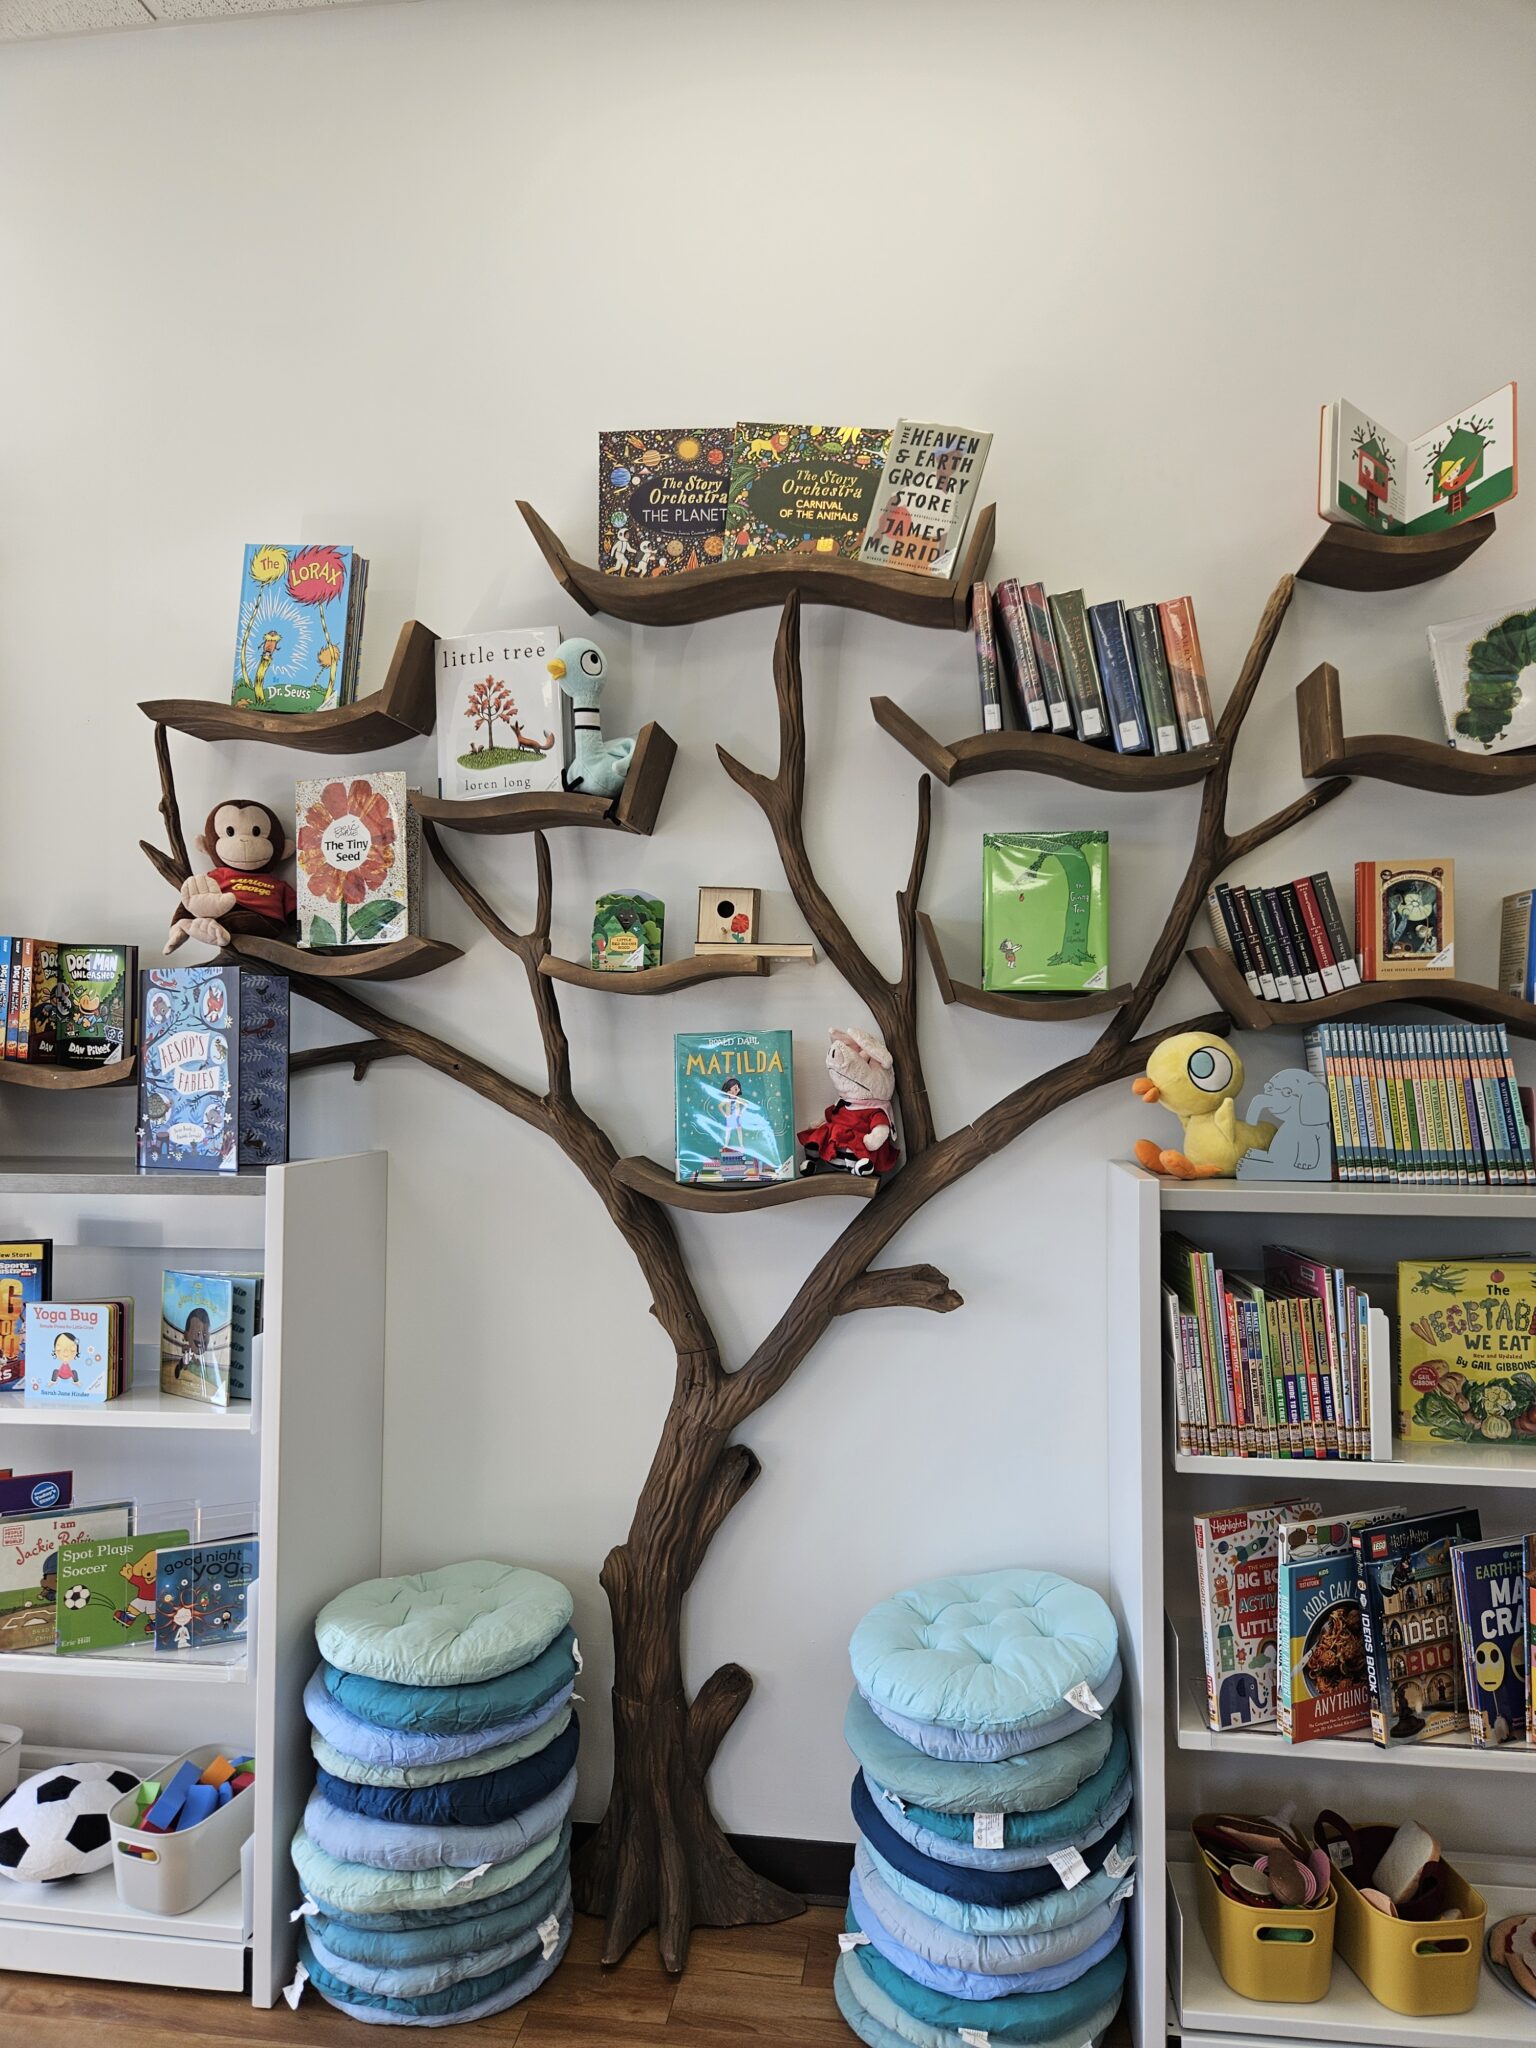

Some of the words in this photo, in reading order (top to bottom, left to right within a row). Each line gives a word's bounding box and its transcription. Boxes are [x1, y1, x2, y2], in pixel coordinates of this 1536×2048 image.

[901, 426, 912, 445] THE
[910, 427, 980, 454] HEAVEN
[895, 449, 910, 464] &
[915, 450, 973, 473] EARTH
[662, 477, 683, 489] The
[685, 475, 723, 492] Story
[797, 470, 818, 480] The
[820, 470, 858, 487] Story
[888, 468, 969, 495] GROCERY
[649, 488, 728, 504] Orchestra
[782, 479, 863, 499] Orchestra
[795, 499, 843, 511] CARNIVAL
[891, 490, 951, 513] STORE
[642, 509, 669, 522] THE
[675, 508, 727, 522] PLANET
[780, 509, 793, 518] OF
[796, 510, 815, 519] THE
[817, 511, 859, 522] ANIMALS
[882, 518, 945, 543] JAMES
[863, 537, 949, 563] McBRID
[260, 558, 279, 570] The
[290, 562, 341, 586] LORAX
[443, 646, 495, 668] little
[504, 646, 546, 660] tree
[1071, 615, 1085, 655] HARRY
[1079, 657, 1093, 697] POTTER
[268, 686, 283, 699] Dr.
[284, 684, 311, 699] Seuss
[465, 780, 498, 791] loren
[503, 776, 531, 789] long
[324, 842, 344, 851] The
[346, 840, 368, 851] Tiny
[336, 852, 360, 862] Seed
[232, 883, 271, 896] George
[66, 954, 91, 973] DOG
[92, 953, 118, 972] MAN
[1256, 953, 1265, 970] REPTILE
[12, 964, 21, 979] DOG
[21, 966, 32, 980] DOG
[71, 971, 115, 980] UNLEASHED
[11, 978, 20, 993] MAN
[21, 980, 31, 994] MAN
[39, 1041, 54, 1052] DAV
[68, 1042, 86, 1055] DAV
[708, 1038, 734, 1046] ROALD
[737, 1036, 760, 1045] DAHL
[161, 1035, 205, 1069] AESOP'S
[686, 1050, 785, 1075] MATILDA
[178, 1070, 215, 1094] FABLES
[1430, 1085, 1438, 1096] MY
[1456, 1082, 1464, 1095] THE
[1447, 1079, 1456, 1109] ELEPHANTS
[1476, 1091, 1484, 1110] HAPPY
[1499, 1080, 1509, 1107] WAITING
[1365, 1101, 1371, 1111] MY
[1431, 1095, 1441, 1121] FRIEND
[1458, 1095, 1467, 1115] THANK
[1461, 1115, 1469, 1128] YOU
[1436, 1129, 1444, 1143] SAD
[1463, 1128, 1471, 1145] BOOK
[0, 1262, 29, 1270] Sports
[1486, 1284, 1510, 1296] The
[33, 1307, 66, 1323] Yoga
[70, 1308, 98, 1325] Bug
[1227, 1315, 1236, 1345] SPAGHETTI
[1464, 1334, 1496, 1350] WE
[1499, 1335, 1532, 1351] EAT
[1455, 1355, 1469, 1369] By
[1471, 1360, 1493, 1371] GAIL
[1496, 1360, 1536, 1372] GIBBONS
[1176, 1362, 1184, 1384] EXTRA
[1275, 1378, 1283, 1397] GUIDE
[1287, 1380, 1295, 1399] GUIDE
[1310, 1377, 1318, 1395] GUIDE
[1322, 1375, 1330, 1394] GUIDE
[1178, 1387, 1186, 1406] YARN
[1277, 1398, 1284, 1406] TO
[1289, 1400, 1296, 1409] TO
[1312, 1397, 1319, 1405] TO
[1325, 1396, 1331, 1404] TO
[1325, 1404, 1333, 1420] SURV
[53, 1521, 57, 1530] I
[60, 1521, 76, 1529] am
[1210, 1519, 1247, 1533] Highlights
[1373, 1540, 1386, 1551] LEGO
[1390, 1533, 1409, 1548] Harry
[1409, 1528, 1430, 1544] Potter
[16, 1538, 55, 1566] Jackie
[62, 1550, 94, 1562] Spot
[97, 1544, 134, 1556] Plays
[62, 1564, 108, 1578] Soccer
[164, 1552, 202, 1576] good
[206, 1549, 243, 1564] night
[1475, 1561, 1523, 1580] EARTH-F
[190, 1562, 253, 1583] yoga
[1236, 1570, 1260, 1590] BIG
[1198, 1565, 1207, 1607] HIGHLIGHTS
[1307, 1579, 1320, 1588] KITCHEN
[1280, 1594, 1289, 1612] KIDS
[1302, 1590, 1328, 1621] KIDS
[1329, 1580, 1352, 1602] CAN
[1280, 1614, 1289, 1630] CAN
[77, 1636, 91, 1644] Hill
[1361, 1613, 1374, 1653] IDEAS
[1203, 1630, 1211, 1669] ACTIVITIES
[1281, 1632, 1289, 1653] COOK
[1406, 1642, 1457, 1676] BOO
[1280, 1652, 1291, 1697] ANYTHING!
[1366, 1656, 1378, 1693] BOOK
[1314, 1687, 1369, 1718] ANYTHING
